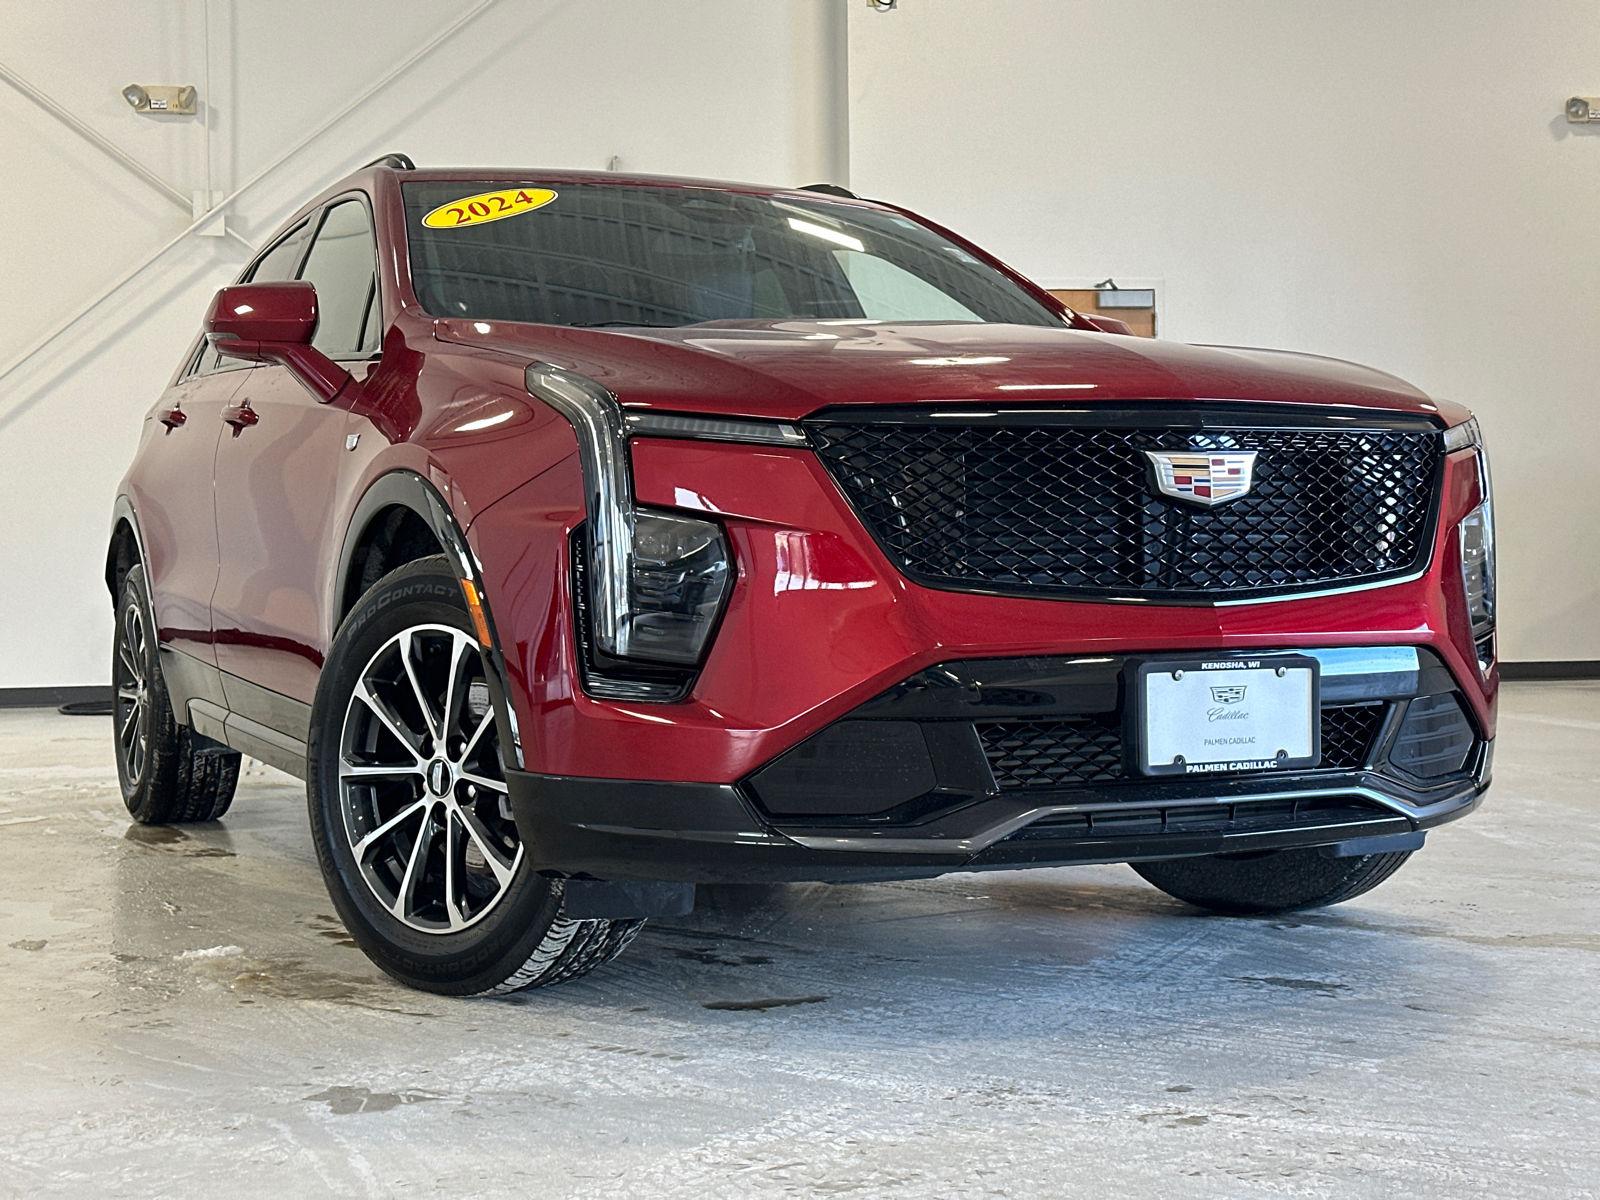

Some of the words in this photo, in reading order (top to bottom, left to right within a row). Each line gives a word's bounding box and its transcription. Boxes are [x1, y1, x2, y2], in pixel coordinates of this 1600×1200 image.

[446, 190, 534, 225] 2024
[346, 583, 459, 641] PROCONTACT
[1201, 661, 1247, 669] KENOSHA,
[1206, 707, 1249, 722] Cadillac
[1204, 737, 1228, 746] PALMEN
[1229, 736, 1256, 744] CADILLAC
[1186, 763, 1228, 773] PALMEN
[1229, 760, 1278, 770] CADILLAC
